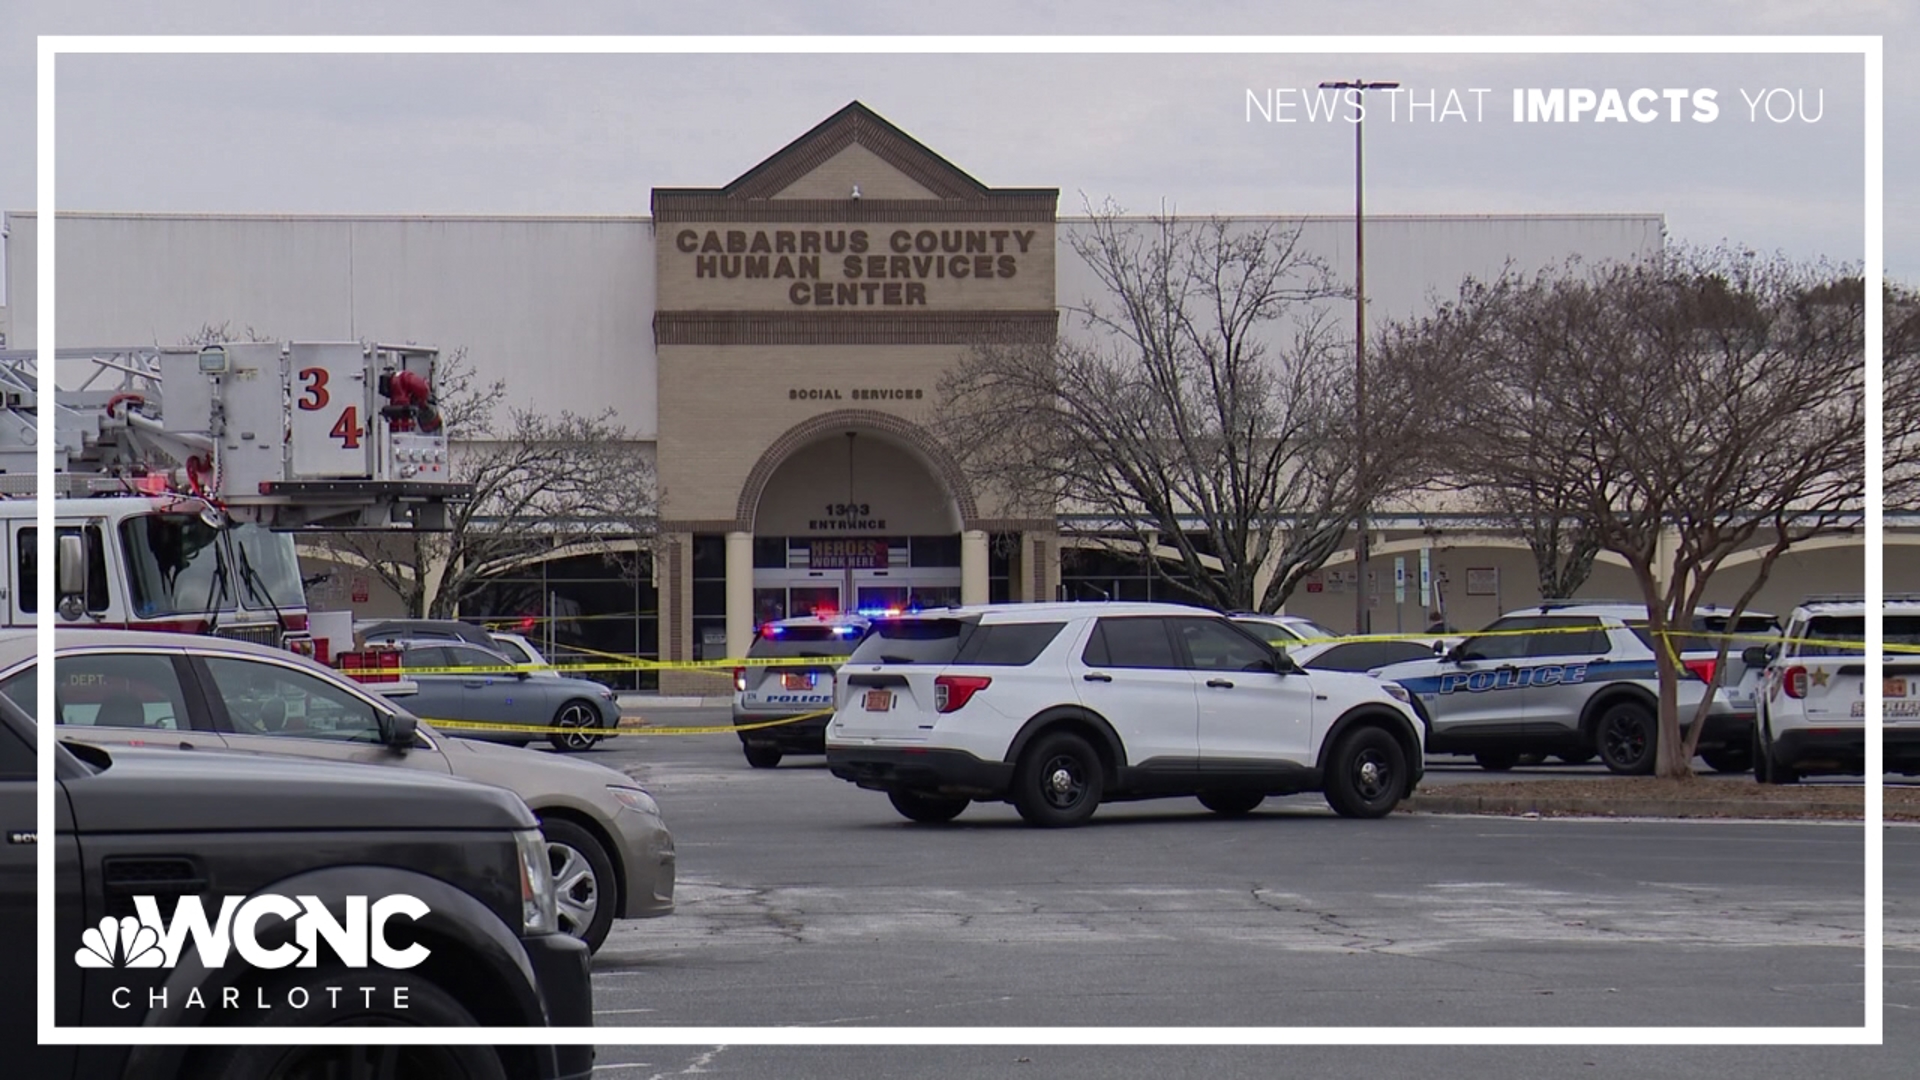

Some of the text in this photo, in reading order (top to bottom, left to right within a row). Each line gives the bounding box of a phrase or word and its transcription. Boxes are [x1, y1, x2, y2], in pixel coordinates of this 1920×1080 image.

[676, 229, 1036, 254] CABARRUS COUNTY
[696, 255, 1018, 279] HUMAN SERVICES
[789, 282, 927, 306] CENTER
[298, 367, 330, 411] 3
[789, 389, 924, 400] SOCIAL SERVICES
[329, 406, 363, 449] 4
[825, 503, 870, 516] 133
[811, 541, 876, 556] HEROES
[811, 556, 875, 568] WORK HERE
[1439, 663, 1588, 695] POLICE
[766, 695, 832, 703] POLICE
